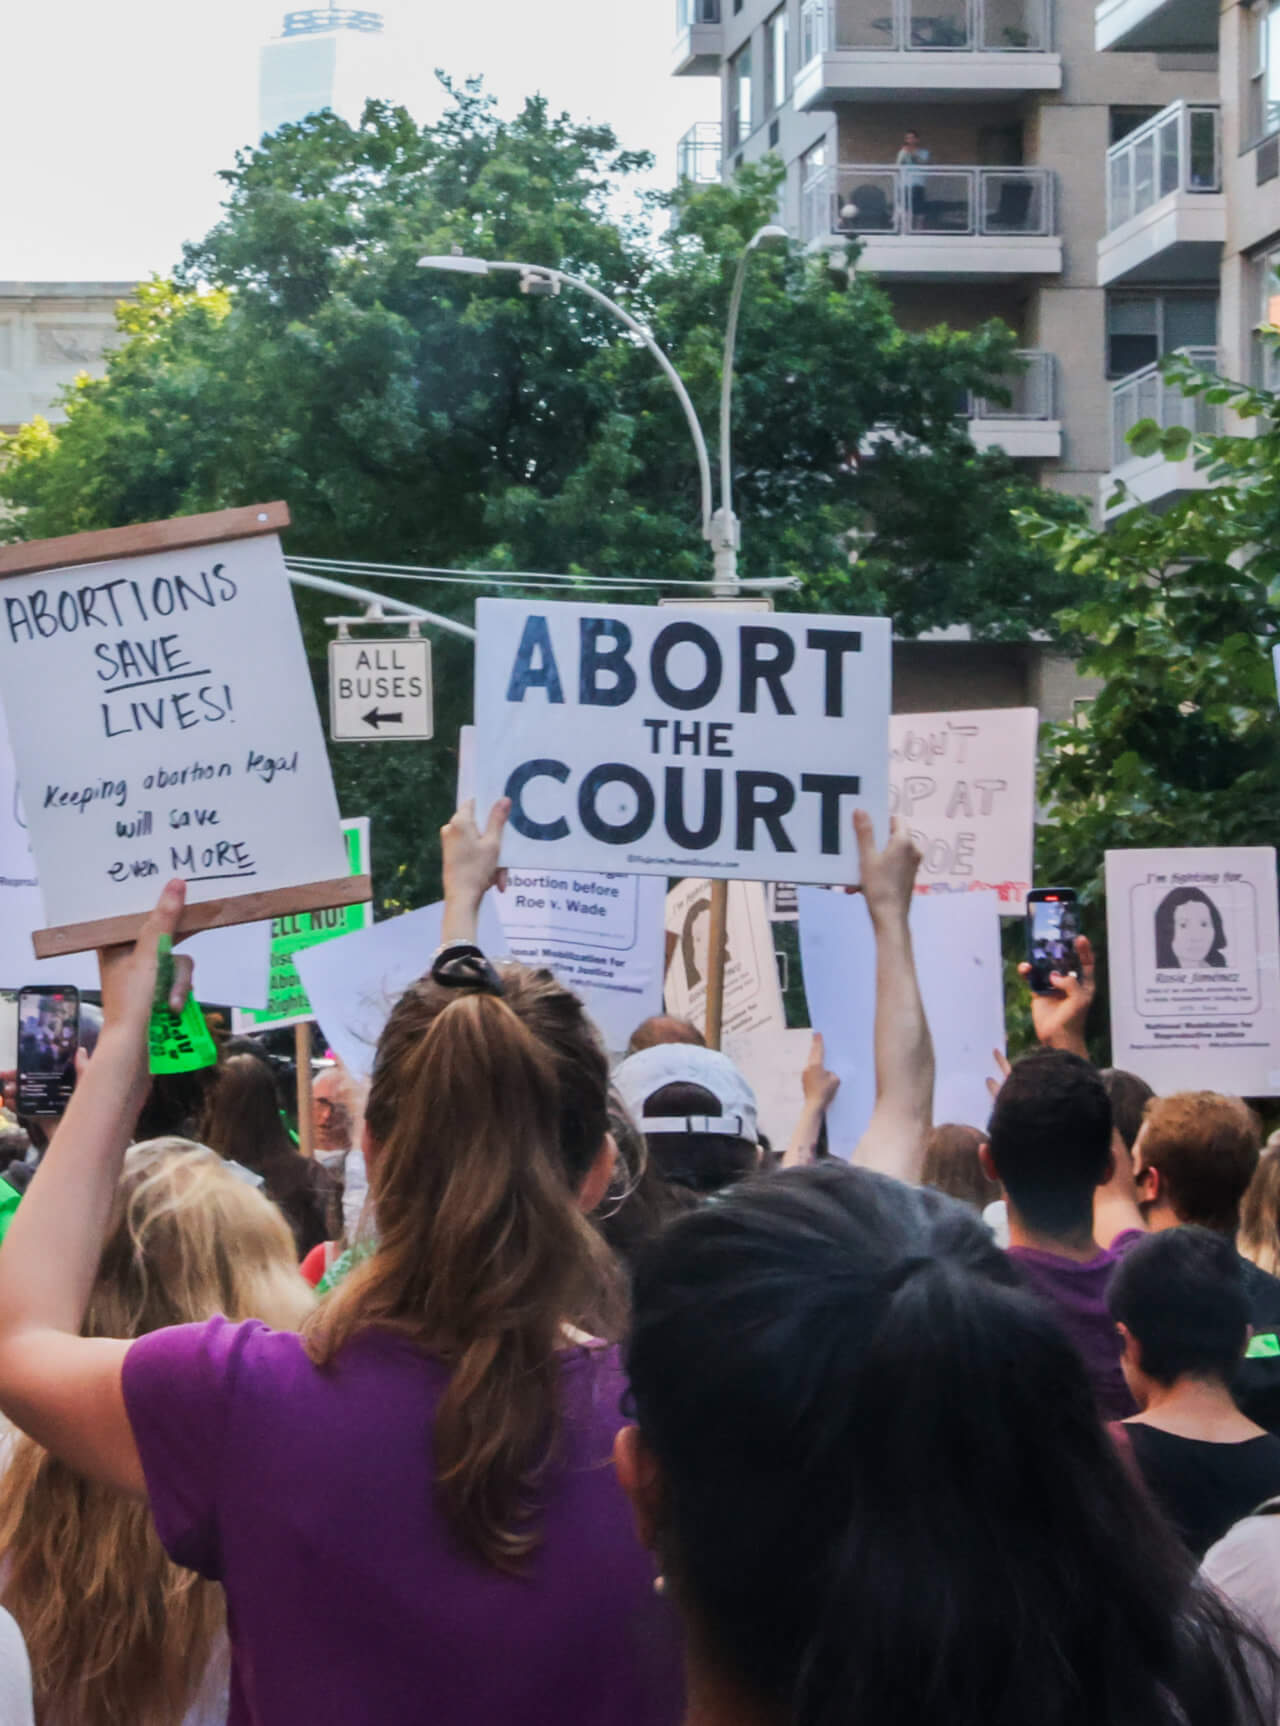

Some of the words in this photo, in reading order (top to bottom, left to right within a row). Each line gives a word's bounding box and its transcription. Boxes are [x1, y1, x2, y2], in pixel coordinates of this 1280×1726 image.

[4, 564, 238, 643] ABORTIONS
[94, 635, 190, 681] SAVE
[355, 649, 405, 671] ALL
[506, 615, 862, 718] ABORT
[339, 676, 422, 699] BUSES
[101, 685, 235, 737] LIVES!
[643, 719, 735, 758] THE
[143, 763, 231, 790] abortion
[246, 751, 299, 782] legal
[116, 811, 153, 839] will
[169, 809, 220, 829] save
[505, 759, 860, 855] COURT
[171, 840, 256, 873] MORE
[515, 895, 545, 908] Roe
[566, 899, 607, 917] Wade
[572, 880, 620, 898] before
